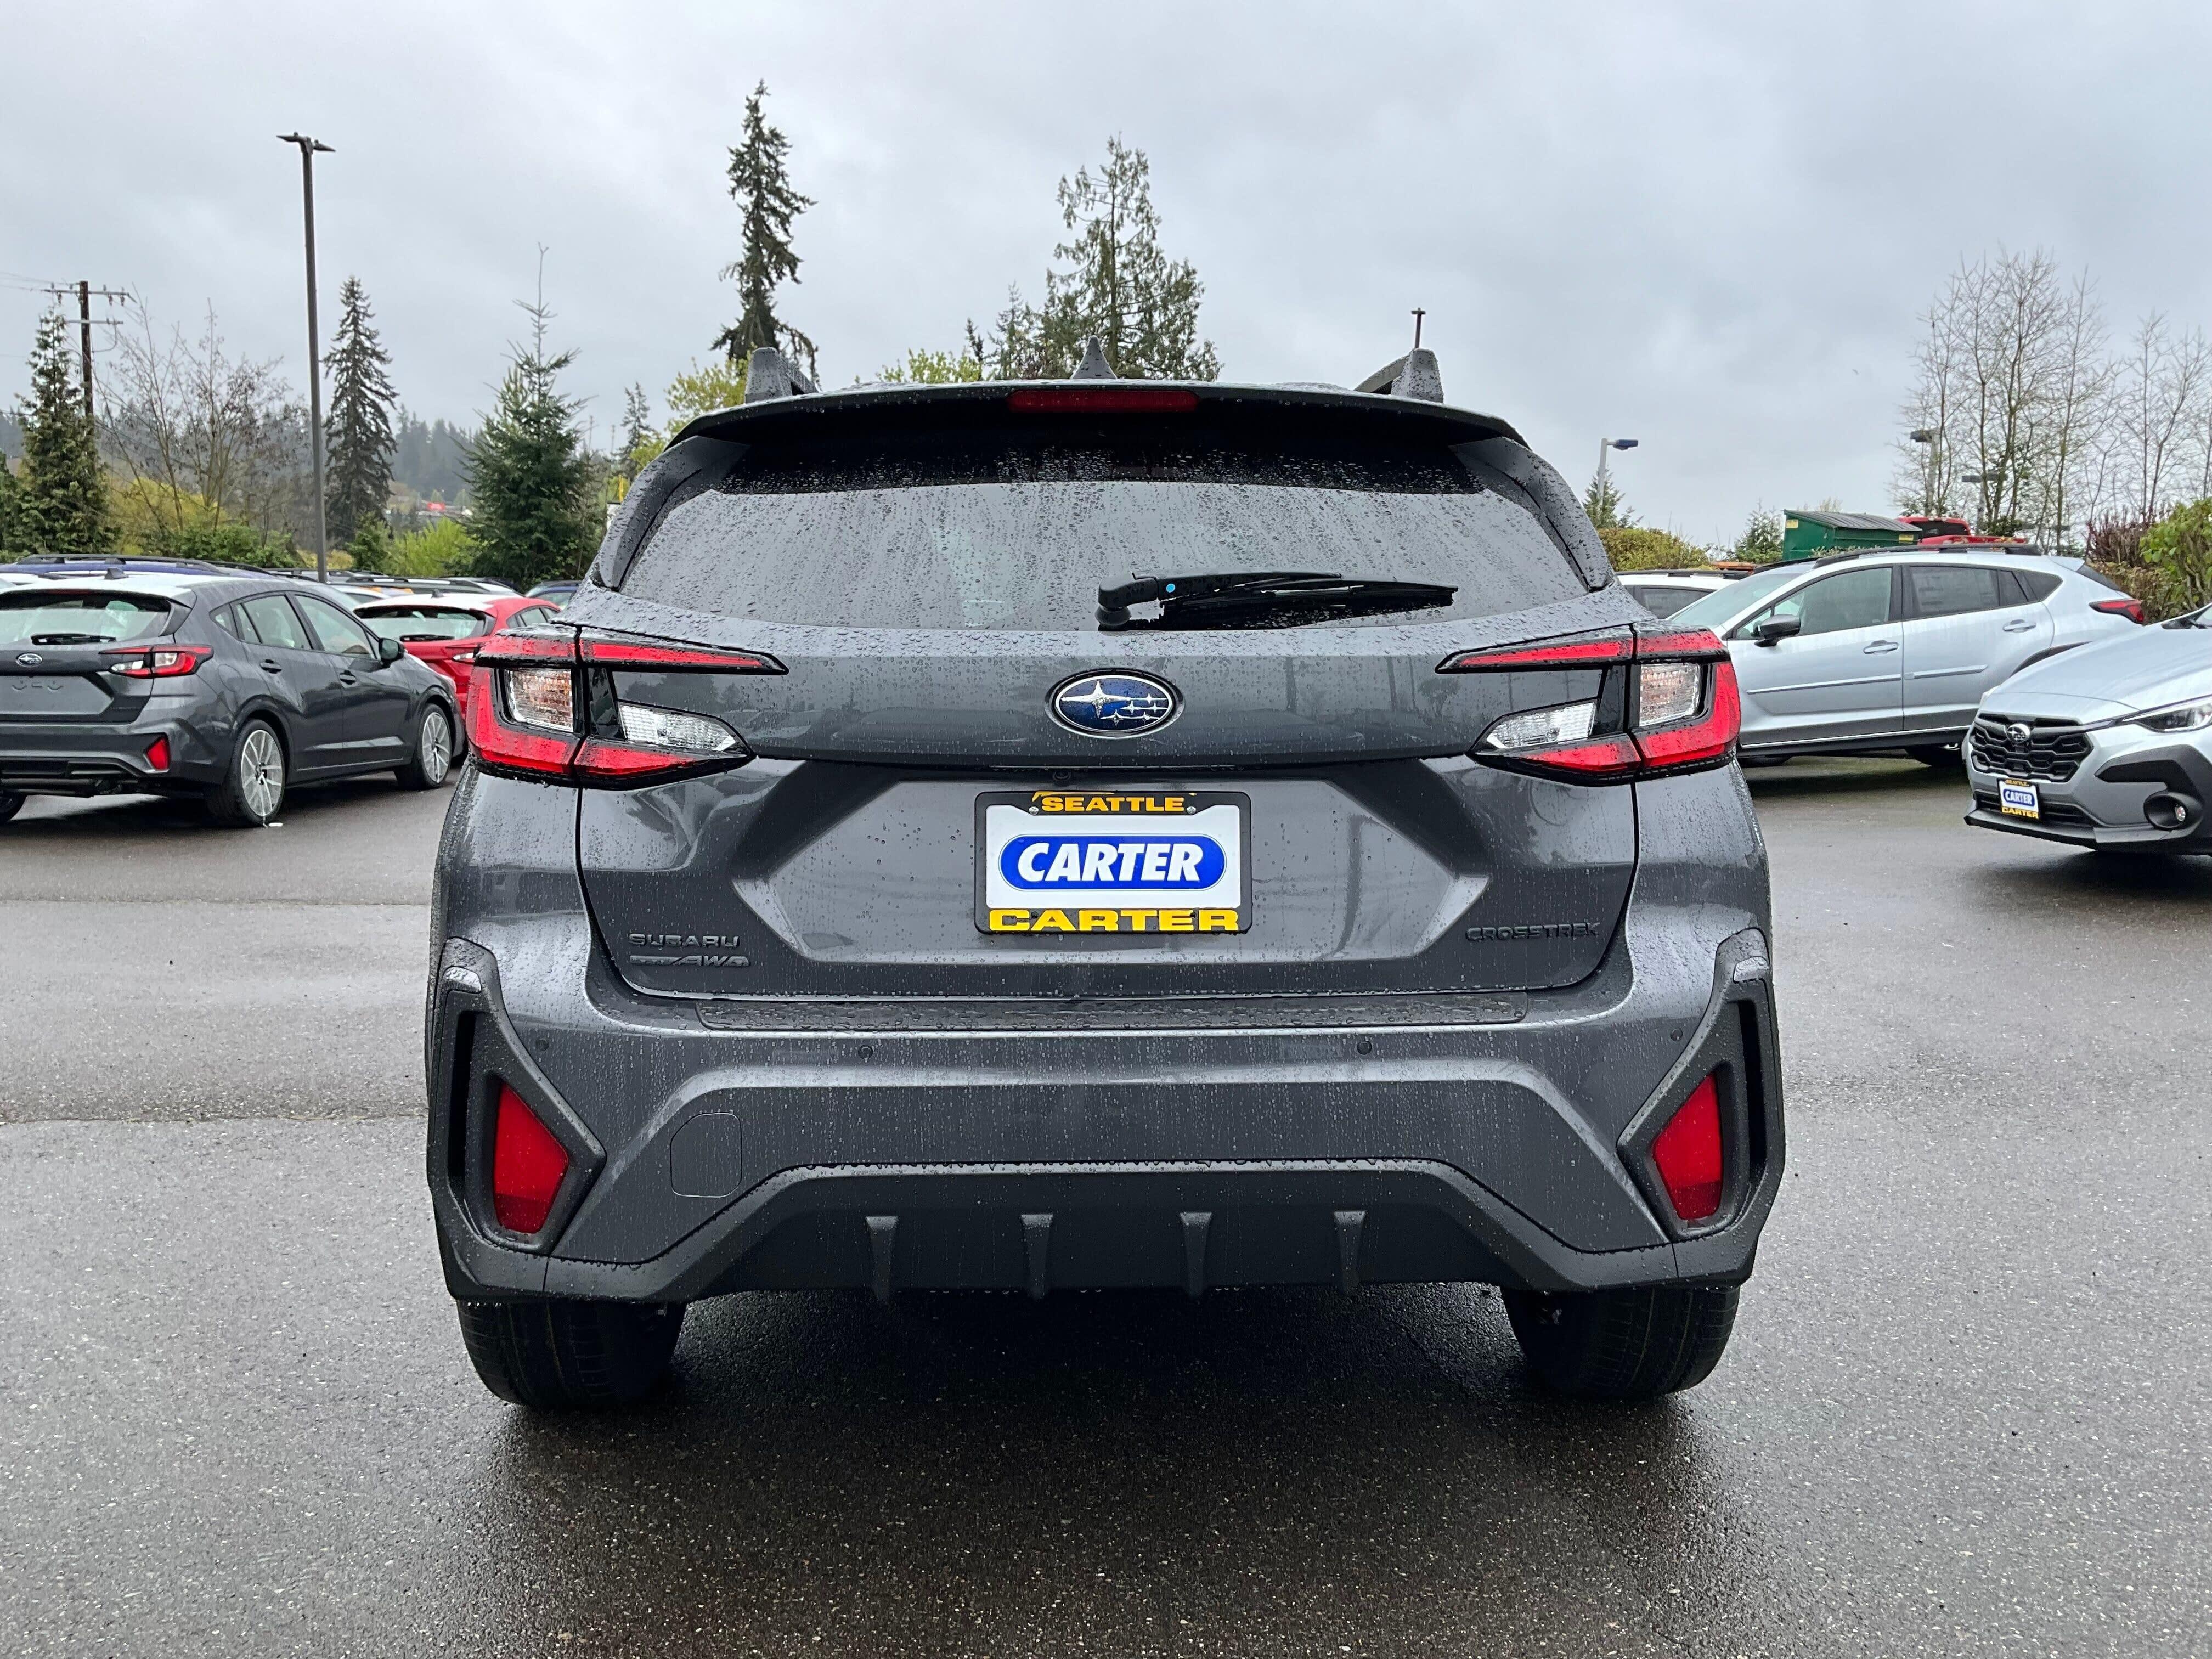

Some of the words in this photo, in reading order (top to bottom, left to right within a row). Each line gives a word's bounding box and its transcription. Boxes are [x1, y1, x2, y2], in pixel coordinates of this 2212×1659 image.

[1042, 797, 1184, 811] SEATTLE
[2005, 791, 2033, 805] CARTER
[2002, 806, 2039, 819] CARTER
[1018, 842, 1203, 882] CARTER
[989, 910, 1238, 931] CARTER
[1466, 923, 1600, 941] CROSSTREK
[629, 933, 740, 947] SUBARU
[670, 955, 751, 966] AWD
